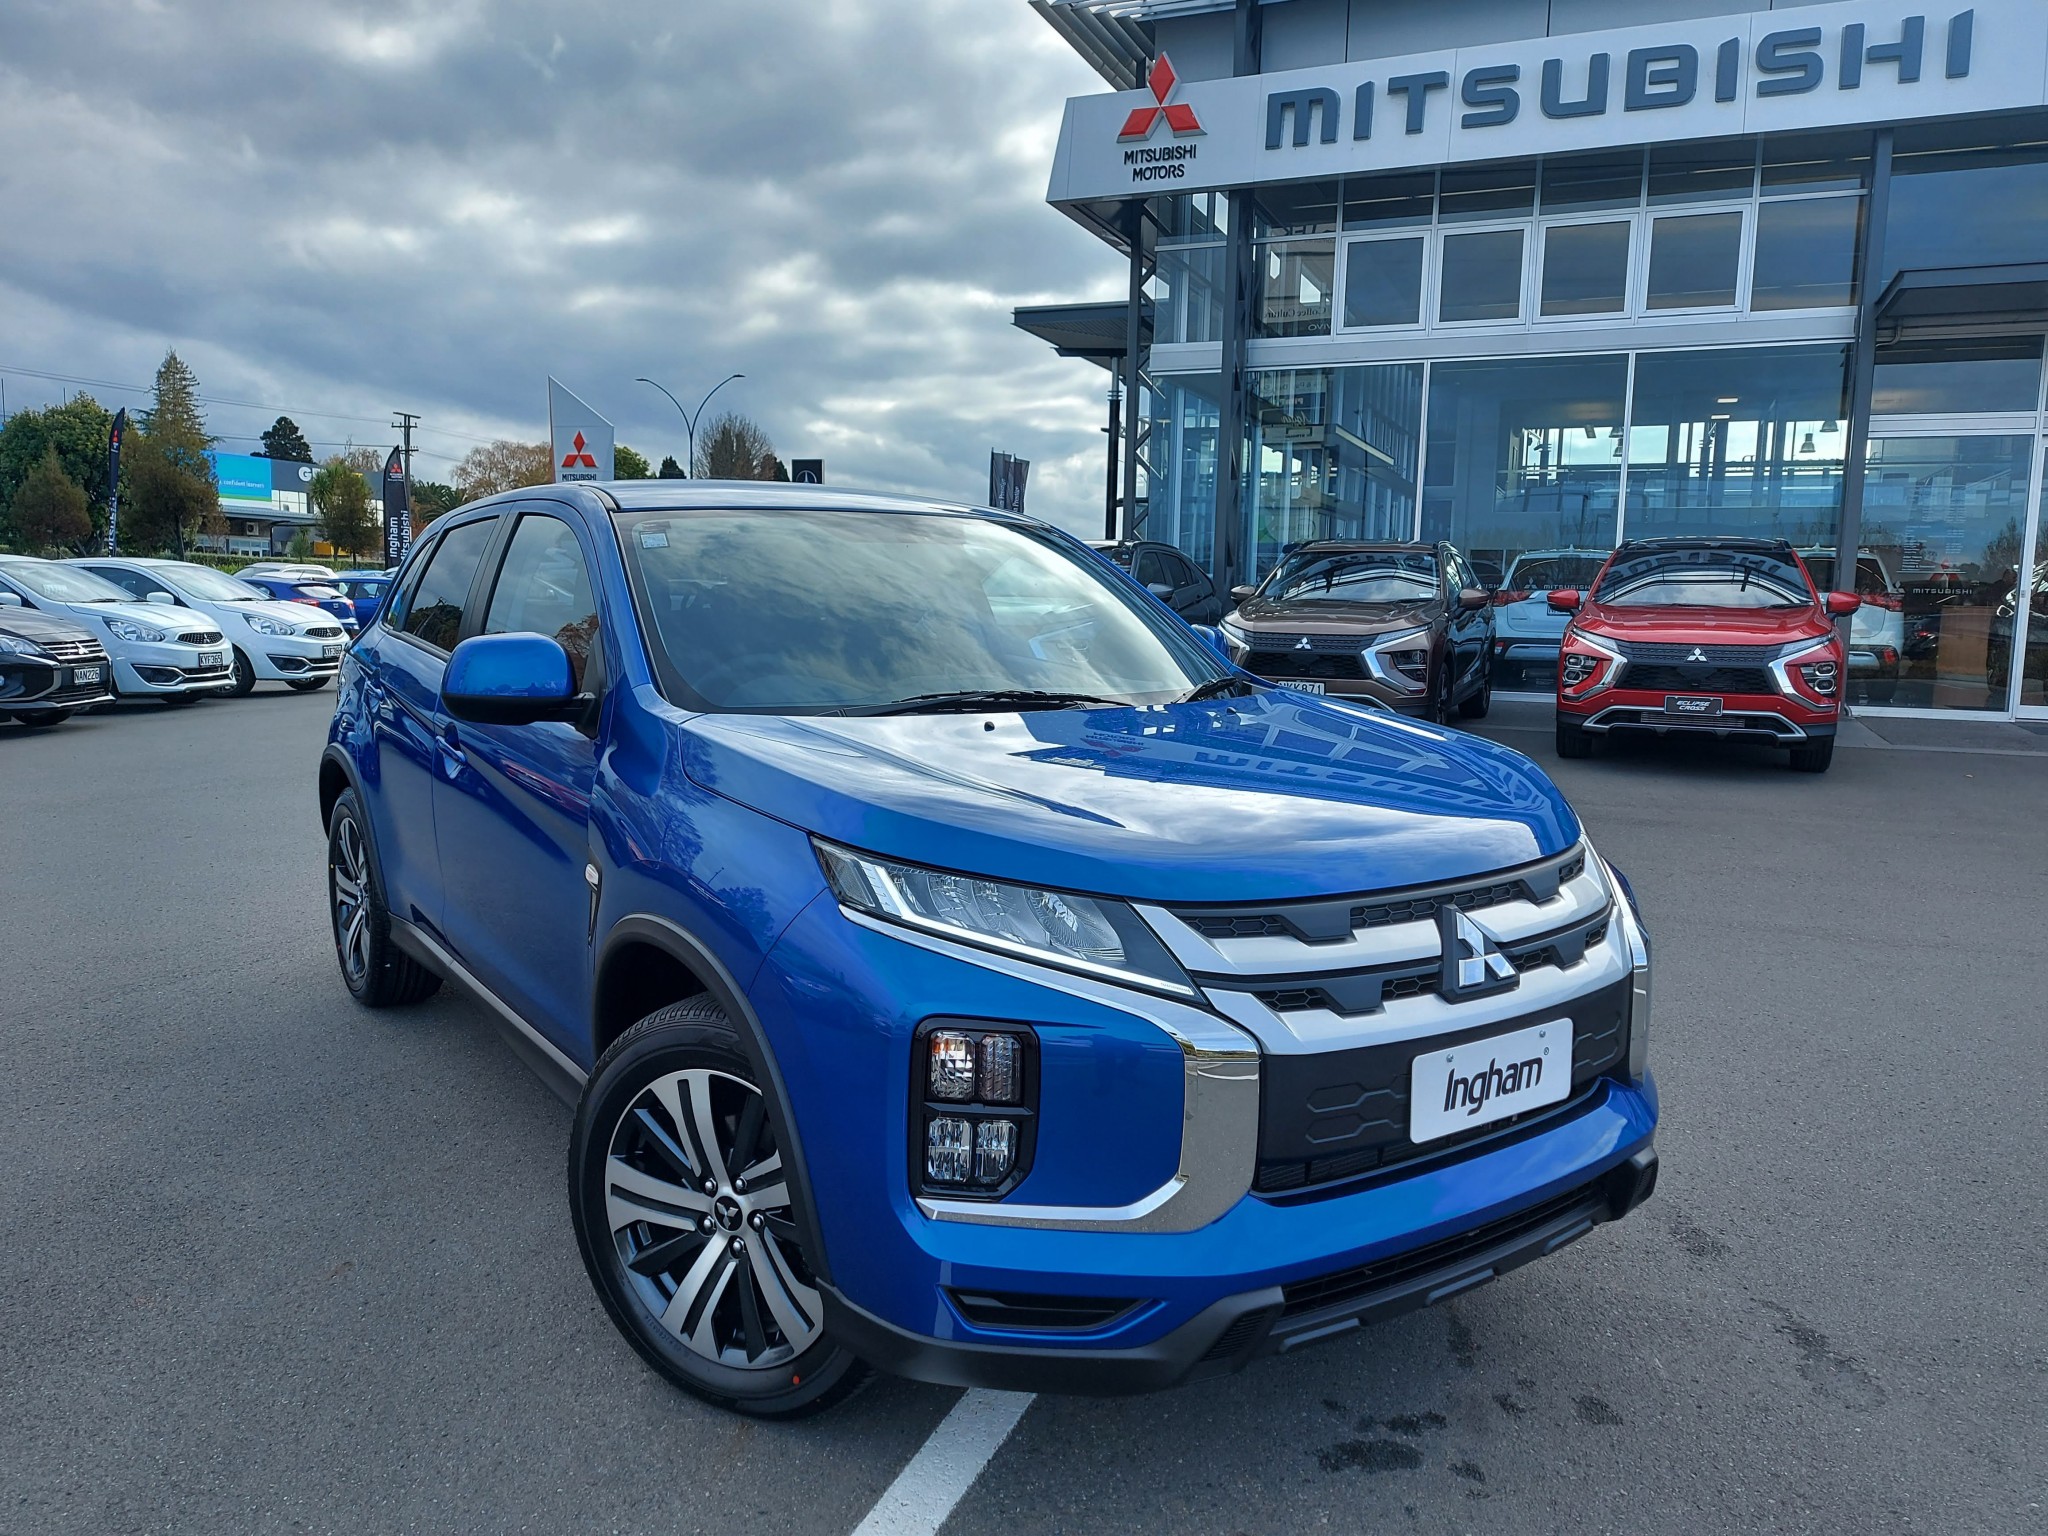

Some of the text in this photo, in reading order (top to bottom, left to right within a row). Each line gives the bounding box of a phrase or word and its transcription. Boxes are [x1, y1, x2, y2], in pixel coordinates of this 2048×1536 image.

[1264, 8, 1975, 151] MITSUBISHI
[1124, 144, 1197, 165] MITSUBISHI
[1132, 163, 1185, 182] MOTORS
[561, 473, 597, 482] MITSUBISHI
[387, 516, 401, 558] Ingham
[200, 654, 222, 664] KYF365
[1676, 699, 1711, 707] ECLIPSE
[1443, 1055, 1543, 1117] Ingham
